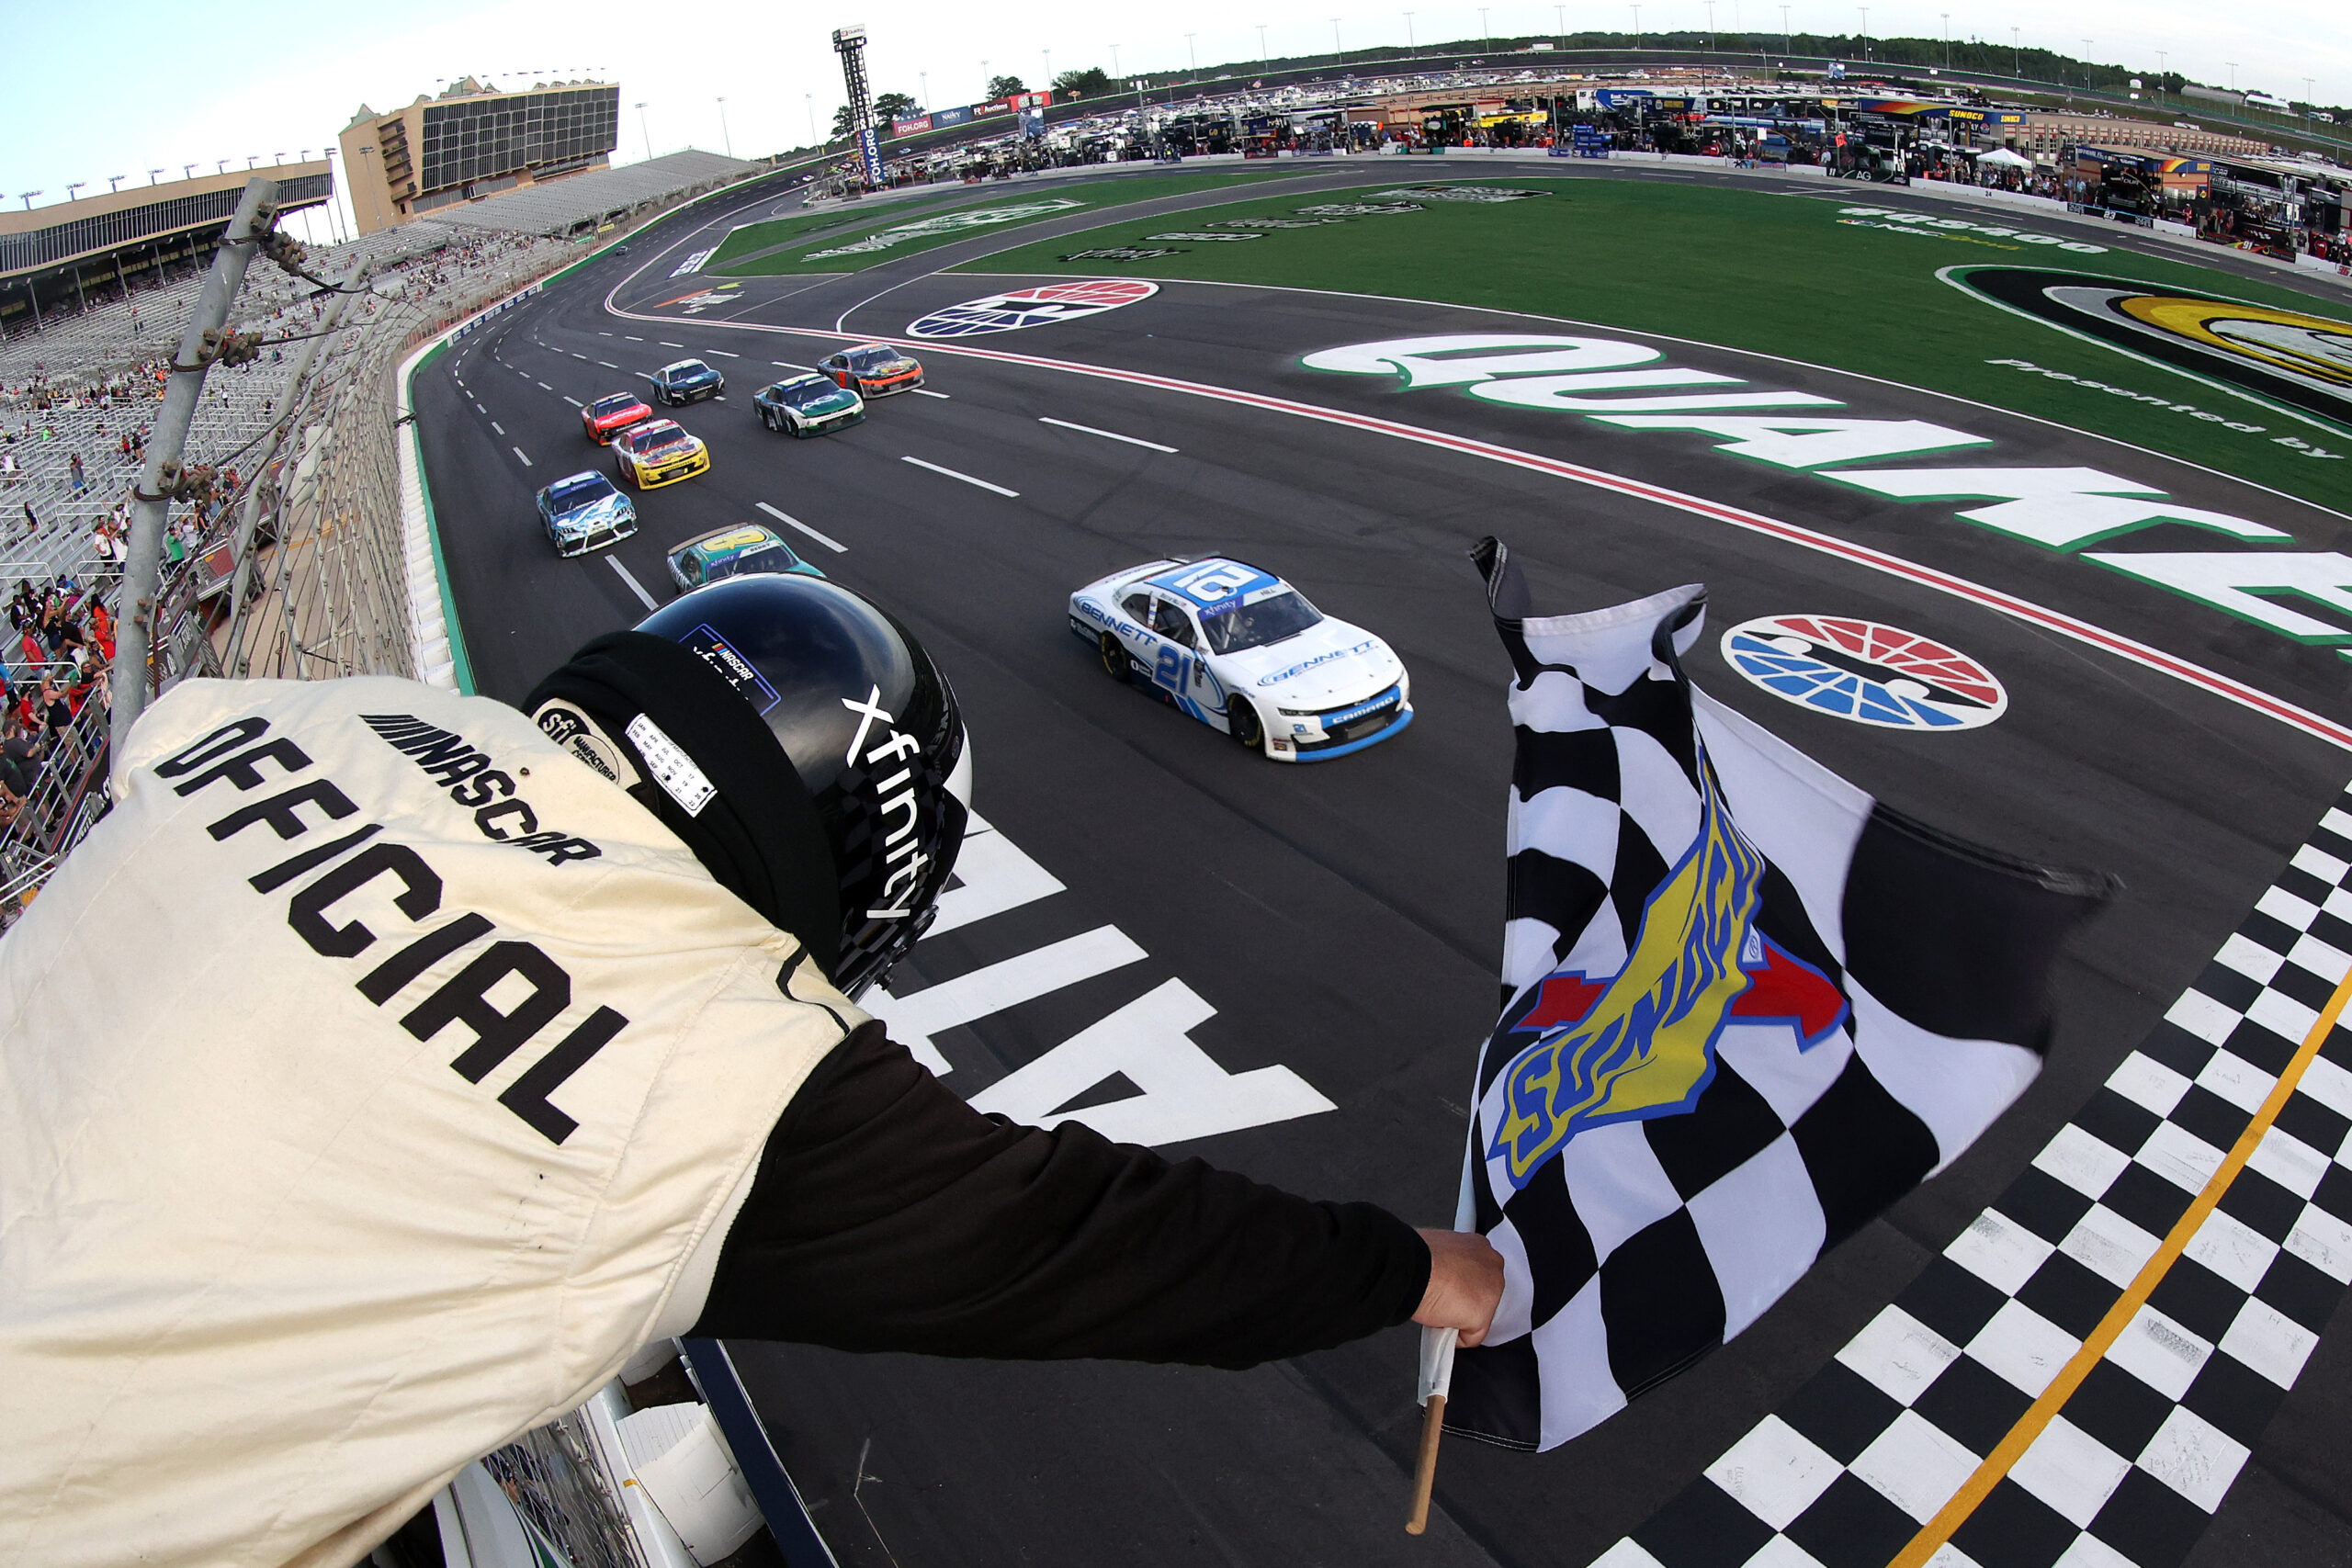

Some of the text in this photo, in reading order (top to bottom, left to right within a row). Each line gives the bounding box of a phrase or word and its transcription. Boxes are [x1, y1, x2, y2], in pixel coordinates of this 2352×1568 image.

[898, 120, 930, 134] FOH.ORG
[1949, 108, 1985, 121] SUNOCO
[2000, 115, 2020, 123] SUNOCO
[865, 129, 883, 184] FOH.ORG
[1856, 170, 1871, 181] AG
[2103, 209, 2117, 220] 23
[2243, 241, 2254, 250] 91
[1984, 359, 2345, 459] Presented by
[1301, 333, 2352, 663] QUAKE
[1081, 602, 1159, 646] BENNETT
[1204, 599, 1237, 616] xfinity
[719, 649, 754, 681] NASCAR
[1154, 643, 1193, 697] 21
[1273, 640, 1374, 682] BENNETT
[1332, 696, 1395, 724] CAMARO
[572, 735, 616, 783] MANUFACTURER
[415, 730, 602, 866] NASCAR
[153, 716, 630, 1145] OFFICIAL
